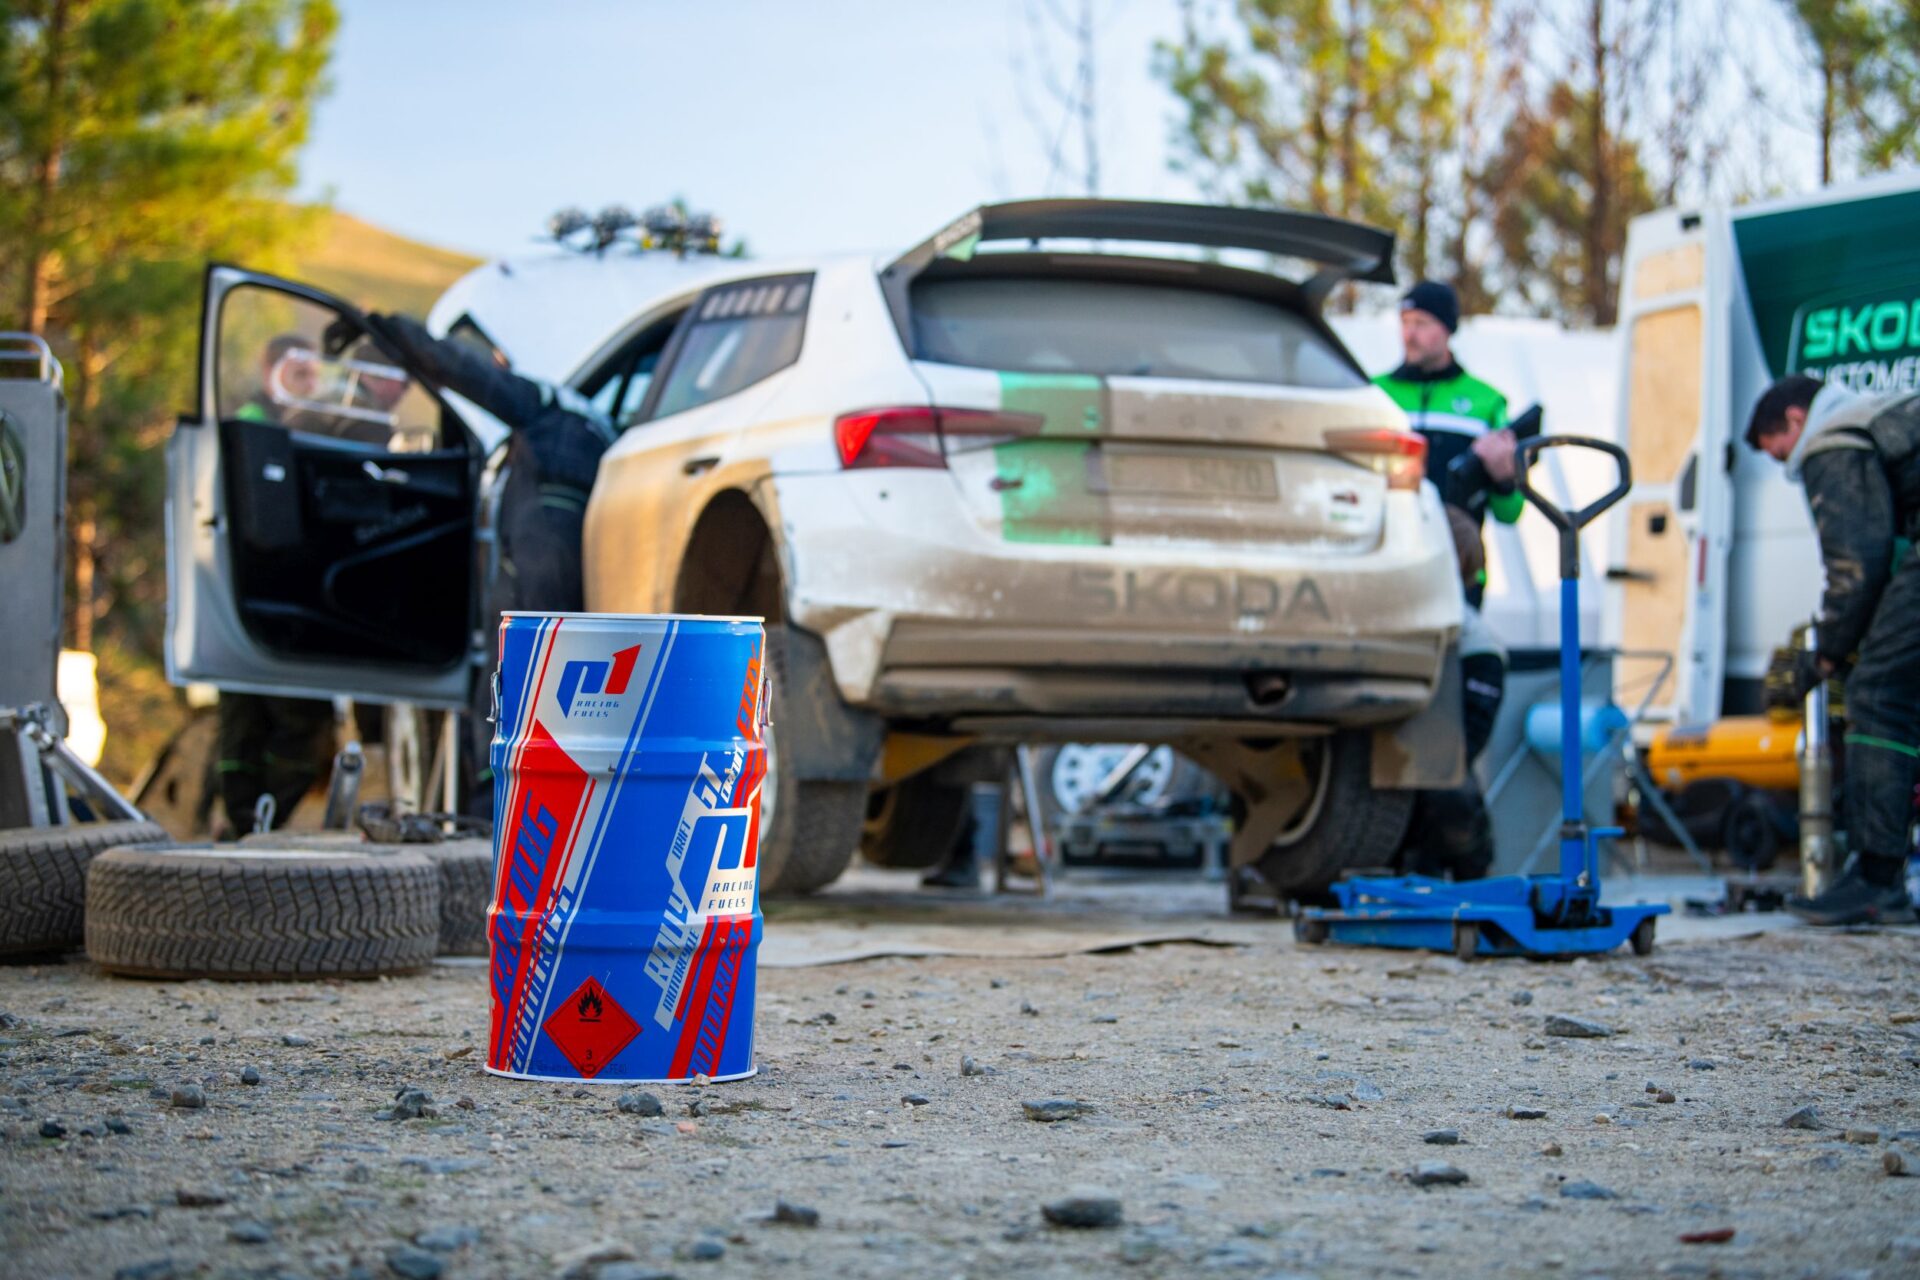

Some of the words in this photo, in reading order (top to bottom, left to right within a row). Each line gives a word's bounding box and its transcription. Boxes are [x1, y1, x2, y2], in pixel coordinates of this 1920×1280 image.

[1804, 355, 1920, 393] STOME
[1071, 568, 1333, 621] SKODA
[573, 710, 609, 718] FUELS
[576, 700, 620, 708] RACING
[672, 817, 691, 860] DRIFT
[711, 879, 754, 893] RACING
[707, 897, 747, 909] FUELS
[643, 888, 697, 990] RALLY
[662, 926, 701, 1013] MOTORCYCLE
[585, 1049, 593, 1060] 3
